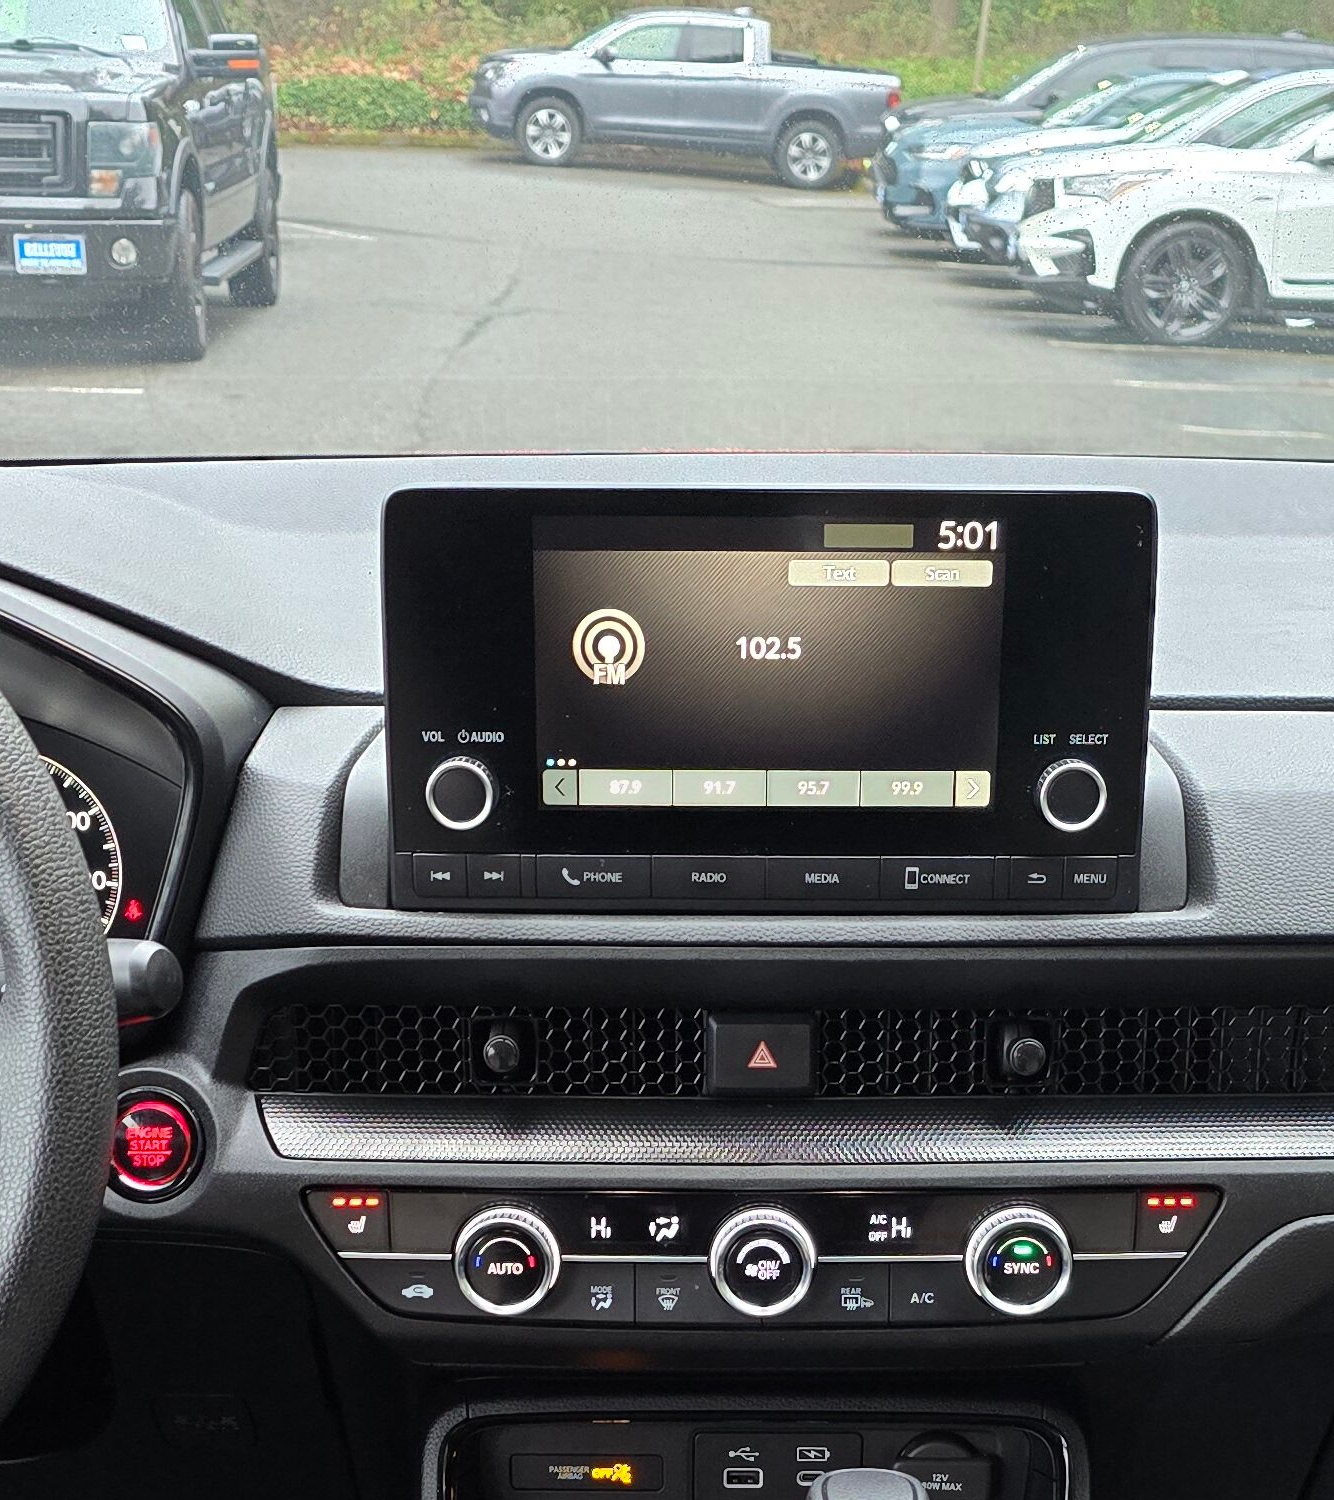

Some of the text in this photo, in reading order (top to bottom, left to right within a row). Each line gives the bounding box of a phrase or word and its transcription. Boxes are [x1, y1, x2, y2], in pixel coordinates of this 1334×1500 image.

[937, 521, 999, 549] 5:01
[823, 564, 856, 581] Text
[925, 565, 960, 582] Scan
[736, 636, 802, 660] 102.5
[593, 663, 627, 685] FM
[422, 731, 445, 743] VOL
[470, 731, 505, 743] AUDIO
[1033, 733, 1056, 746] LIST
[1069, 733, 1109, 746] SELECT
[610, 780, 643, 796] 87.9
[703, 780, 736, 796] 91.7
[797, 780, 830, 796] 95.7
[891, 780, 924, 796] 99.9
[583, 869, 623, 883] PHONE
[691, 871, 727, 885] RADIO
[805, 871, 840, 885] MEDIA
[920, 871, 971, 886] CONNECT
[1073, 871, 1107, 885] MENU
[126, 1126, 173, 1139] ENGINE
[129, 1139, 168, 1152] START
[133, 1154, 165, 1166] STOP
[870, 1214, 888, 1225] A/C
[868, 1231, 887, 1241] OFF
[487, 1262, 523, 1275] AUTO
[758, 1270, 780, 1280] OFF
[1004, 1263, 1039, 1274] SYNC
[590, 1285, 612, 1294] MODE
[656, 1287, 680, 1295] FRONT
[841, 1287, 862, 1295] REAR
[910, 1292, 935, 1304] A/C
[548, 1465, 590, 1473] PASSENGER
[932, 1473, 949, 1482] 12V
[941, 1482, 963, 1491] MAX
